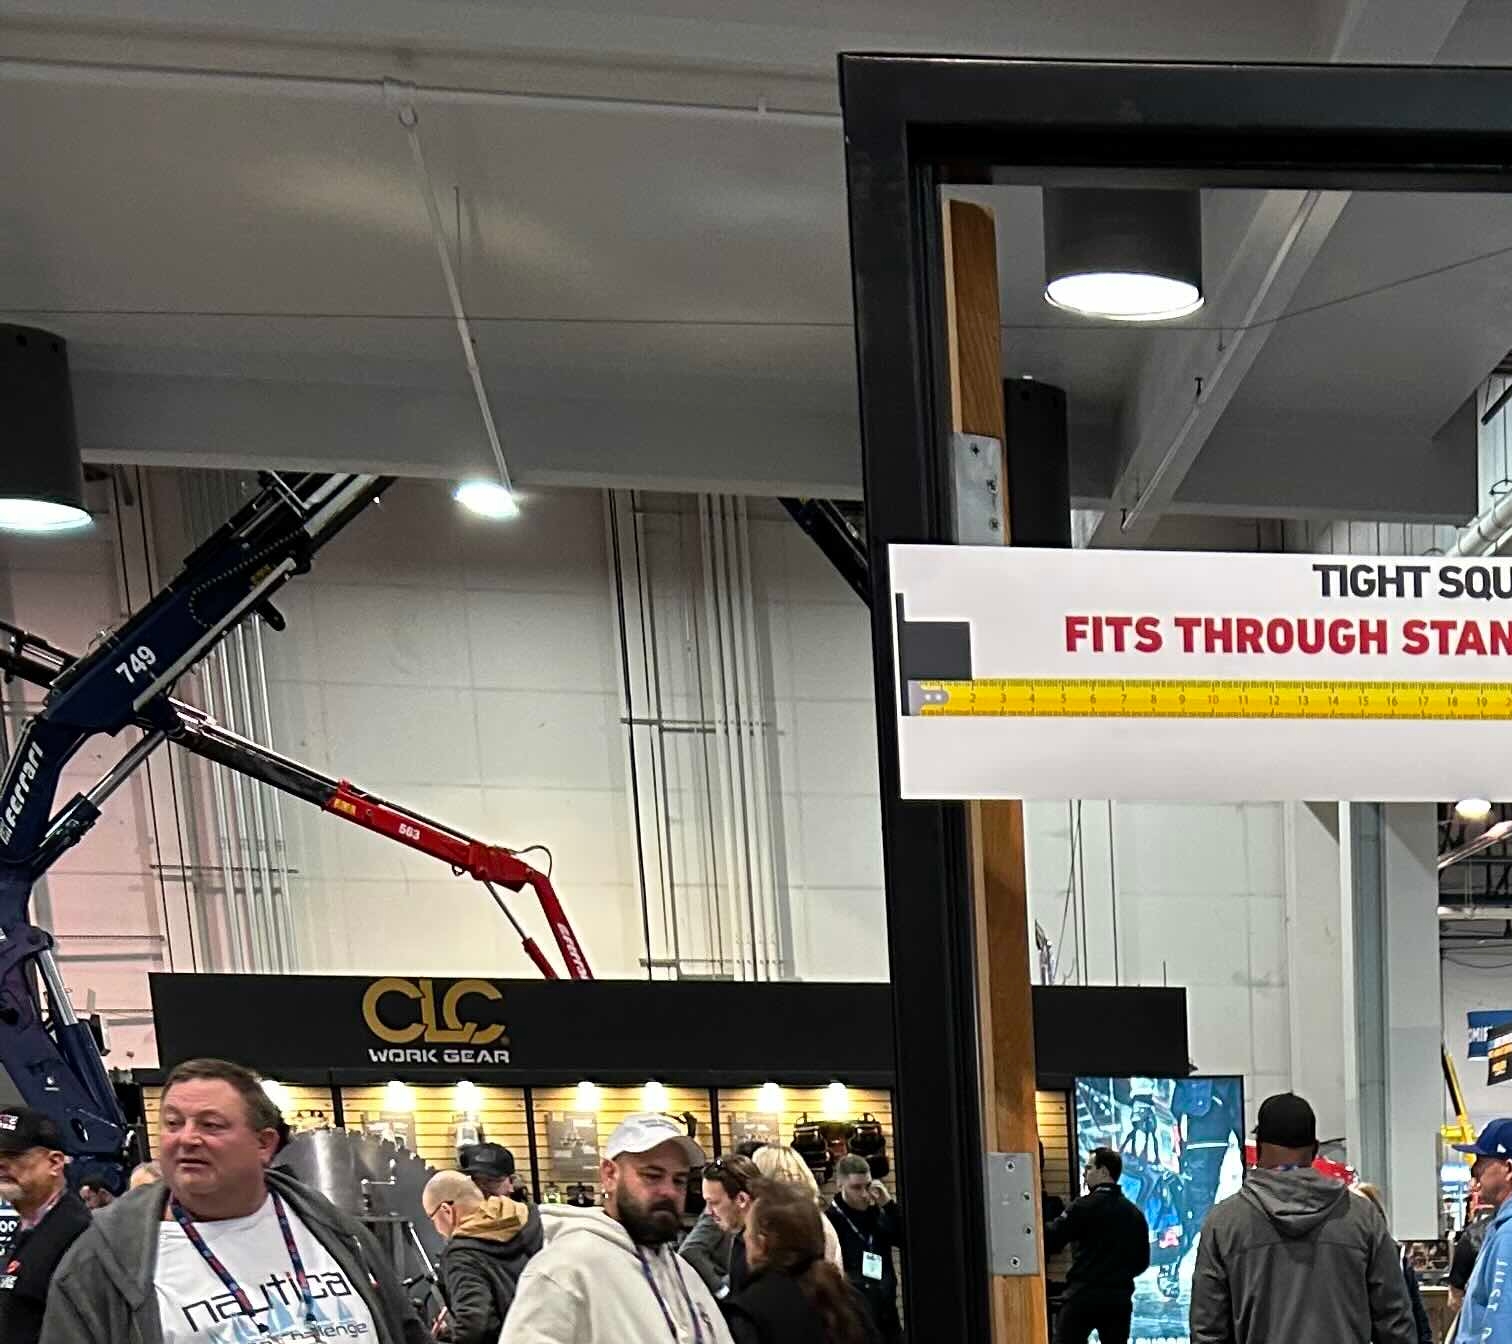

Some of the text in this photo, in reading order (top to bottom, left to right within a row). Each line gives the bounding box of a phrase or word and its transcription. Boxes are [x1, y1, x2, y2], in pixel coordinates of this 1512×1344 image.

[1313, 564, 1431, 598] TIGHT
[1065, 616, 1162, 654] FITS
[1174, 617, 1388, 655] THROUGH
[115, 645, 156, 683] 749
[969, 692, 977, 704] 2
[999, 692, 1007, 704] 3
[1028, 693, 1036, 704] 4
[1059, 693, 1068, 705] 5
[1089, 693, 1097, 704] 6
[1120, 693, 1128, 705] 7
[1149, 694, 1158, 705] 8
[1178, 694, 1186, 705] 9
[1207, 694, 1220, 705] 10
[1238, 695, 1249, 706] 11
[1268, 695, 1280, 707] 12
[1298, 695, 1310, 707] 13
[1327, 695, 1340, 707] 14
[1358, 695, 1369, 707] 15
[1386, 695, 1399, 707] 16
[1418, 695, 1429, 707] 17
[1447, 696, 1459, 708] 18
[1476, 696, 1488, 708] 19
[362, 977, 507, 1045] CLC
[368, 1049, 511, 1064] WORK GEAR
[181, 1271, 353, 1333] nautica
